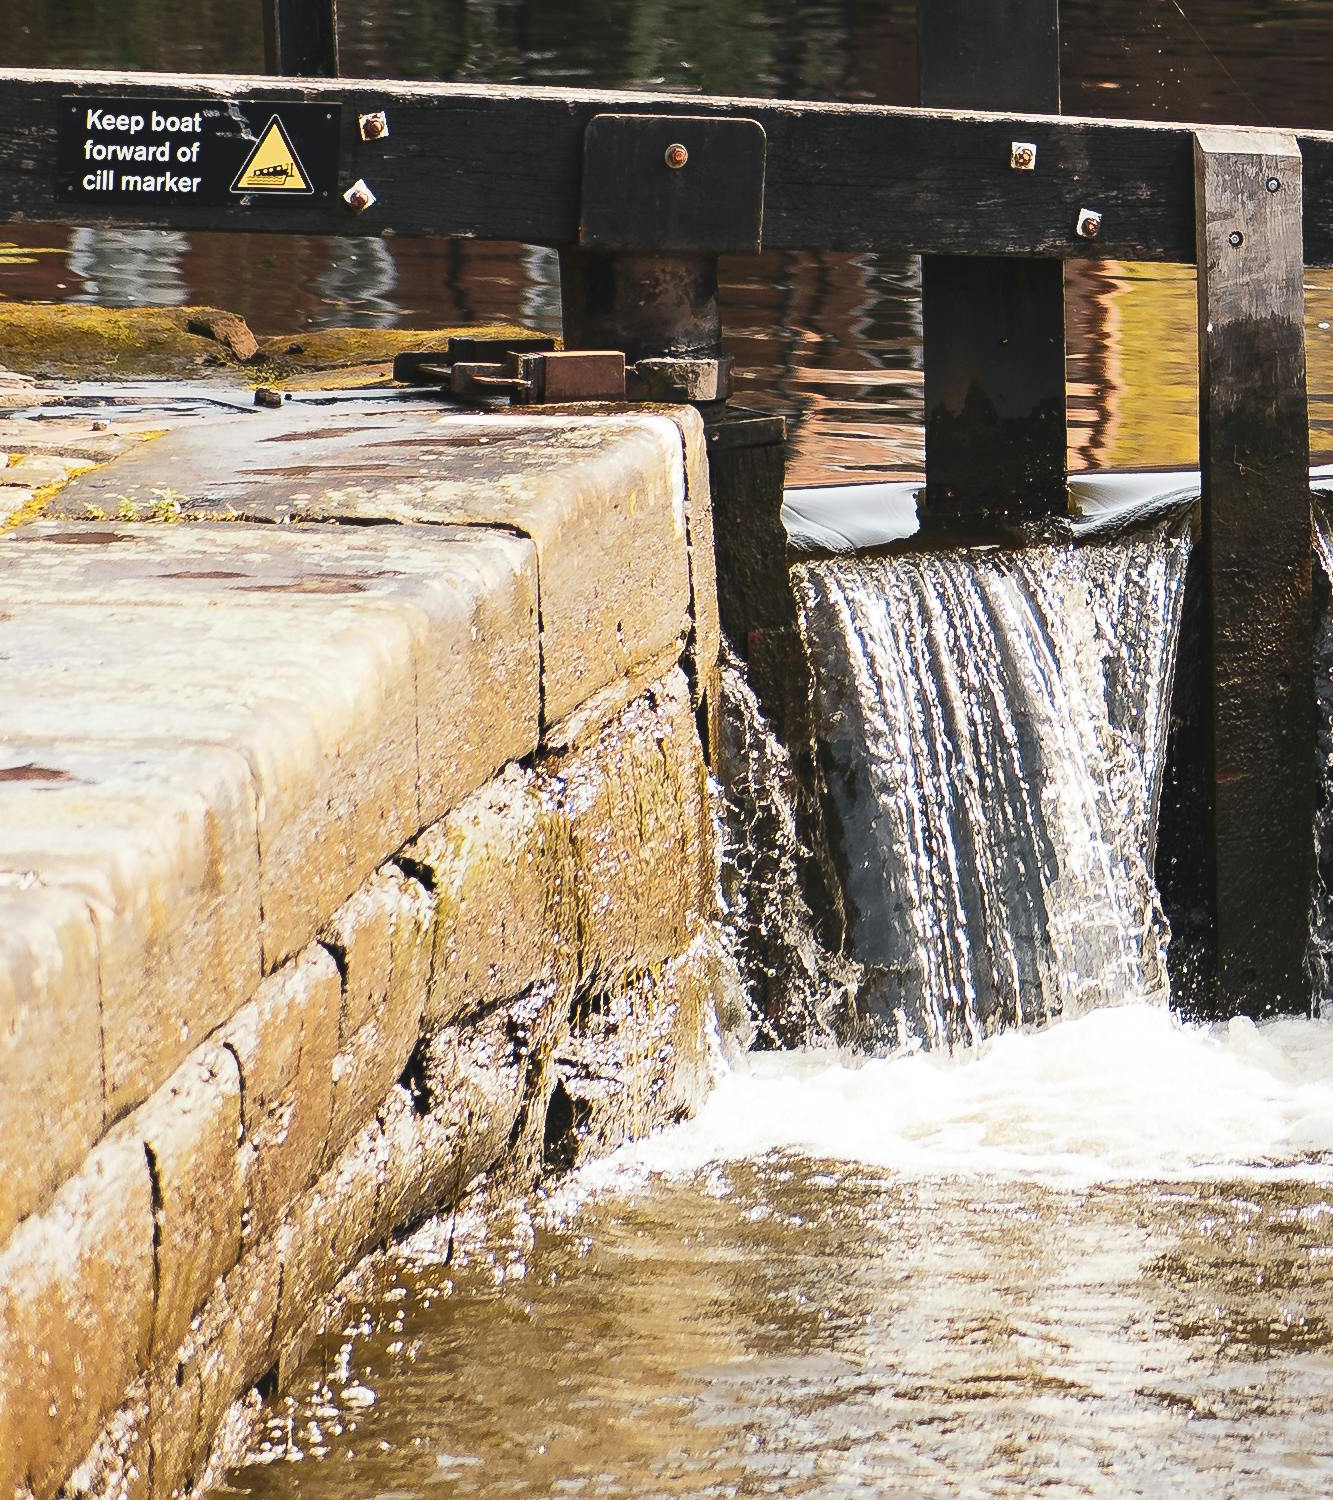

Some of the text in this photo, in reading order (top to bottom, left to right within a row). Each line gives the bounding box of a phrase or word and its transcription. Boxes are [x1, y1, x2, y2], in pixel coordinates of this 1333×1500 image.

[87, 109, 202, 135] Keep boat
[84, 140, 200, 162] forward of
[83, 170, 201, 193] cill marker
